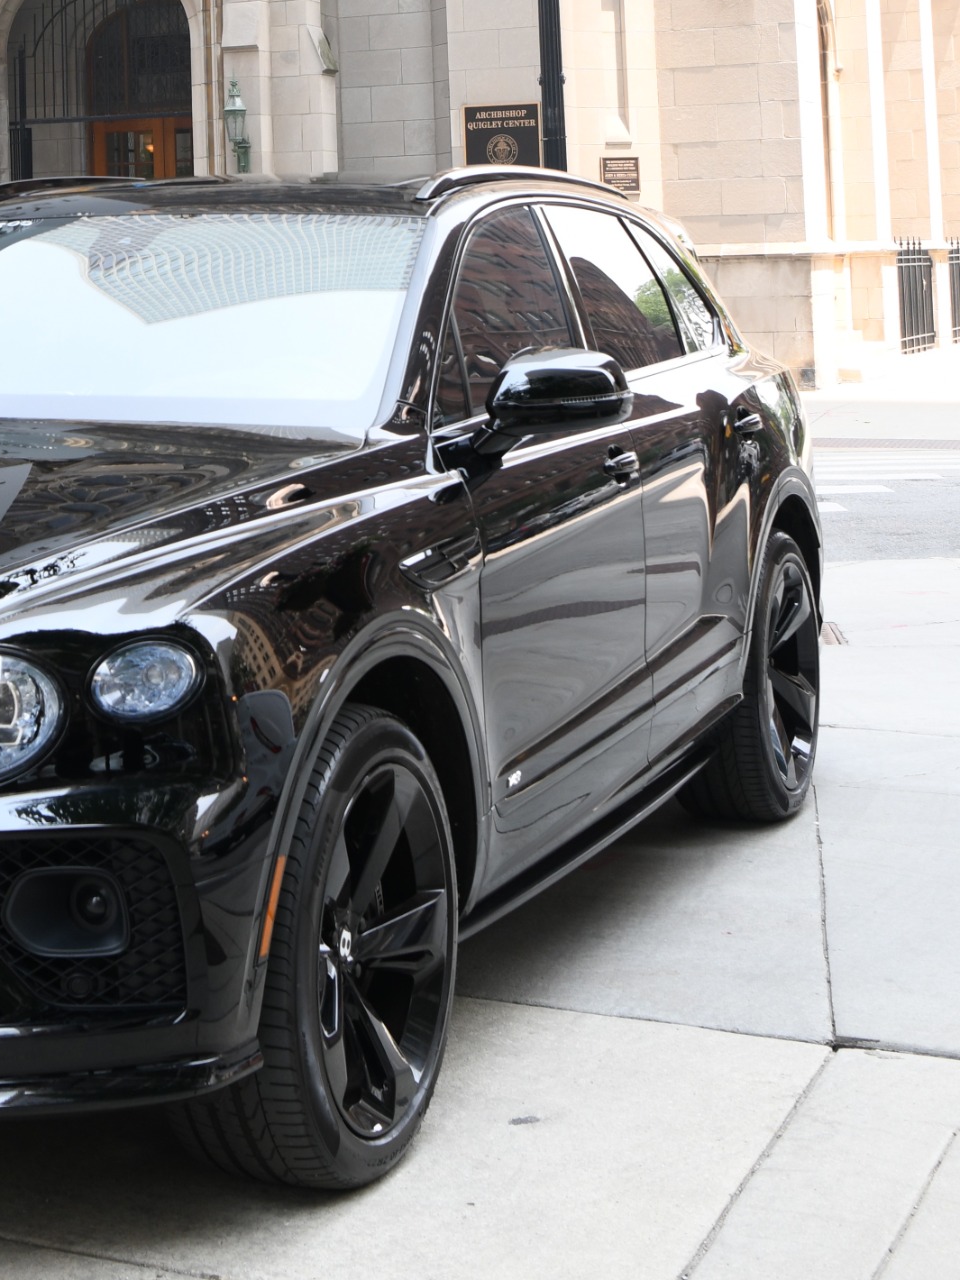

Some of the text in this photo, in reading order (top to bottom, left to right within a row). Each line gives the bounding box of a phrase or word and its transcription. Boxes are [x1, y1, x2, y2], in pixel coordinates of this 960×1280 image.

[475, 109, 527, 120] ARCHBISHOP
[467, 118, 536, 131] QUIGLEY CENTER
